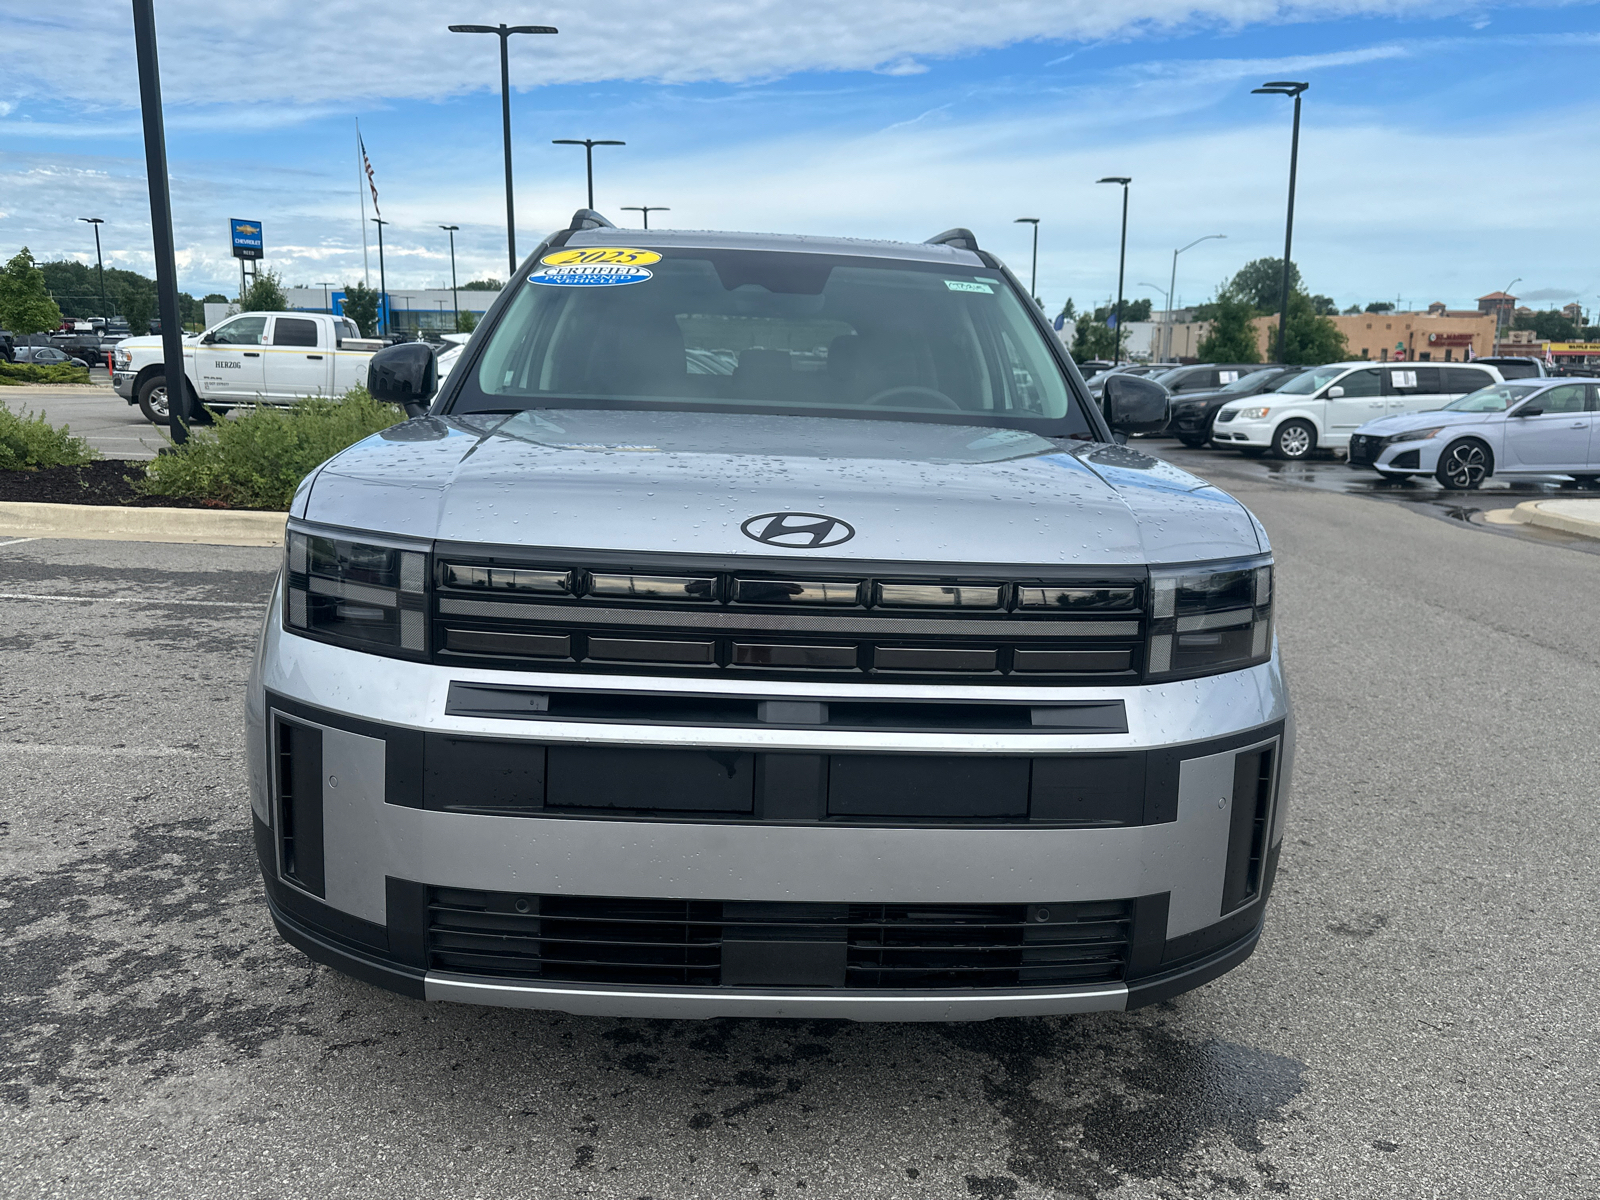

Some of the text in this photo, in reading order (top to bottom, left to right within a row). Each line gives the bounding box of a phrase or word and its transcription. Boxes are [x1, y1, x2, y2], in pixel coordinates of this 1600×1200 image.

[234, 238, 261, 246] CHEVROLET
[557, 251, 647, 265] 2025
[544, 266, 640, 275] CERTIFIED
[215, 360, 242, 369] HERZOG
